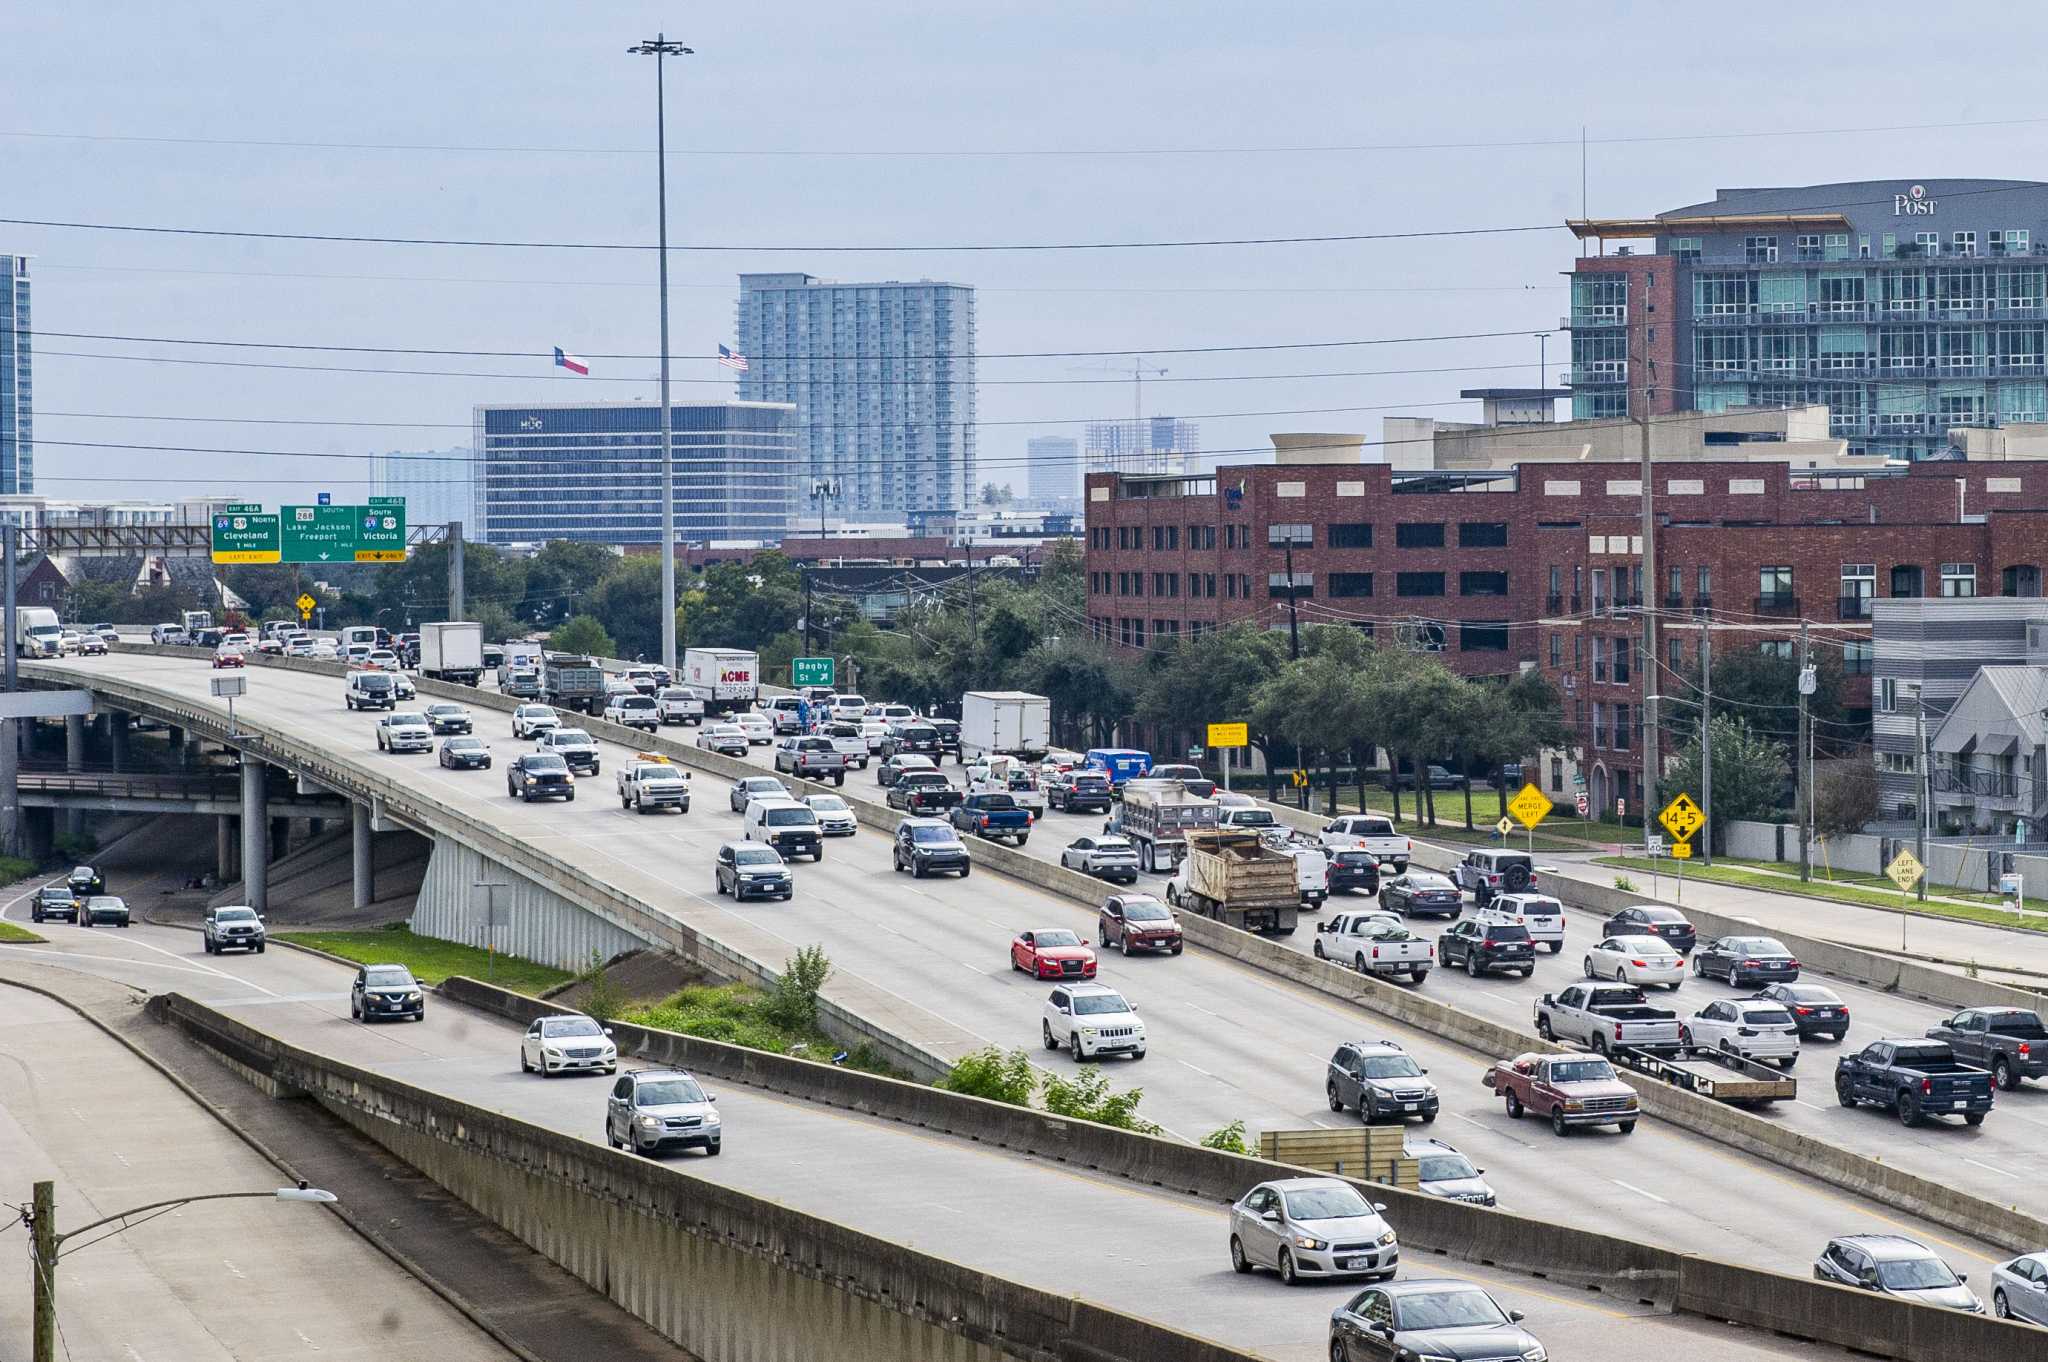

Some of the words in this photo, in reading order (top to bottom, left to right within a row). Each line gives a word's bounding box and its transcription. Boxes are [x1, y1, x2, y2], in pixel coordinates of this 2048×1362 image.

[297, 512, 313, 520] 288
[368, 508, 392, 516] SOUTH
[217, 519, 229, 528] 69
[234, 519, 246, 528] 59
[286, 523, 307, 531] Lake
[314, 523, 351, 531] Jackson
[384, 519, 395, 528] 59
[224, 532, 268, 540] Cleveland
[300, 532, 337, 541] Freeport
[363, 531, 398, 540] Victoria
[385, 552, 403, 560] ONLY
[798, 662, 829, 672] Bagby
[720, 671, 750, 682] ACME
[799, 673, 809, 682] St
[1649, 844, 1661, 852] 40
[1897, 859, 1913, 867] LEFT
[1896, 867, 1914, 875] LANE
[1897, 875, 1915, 883] ENDS
